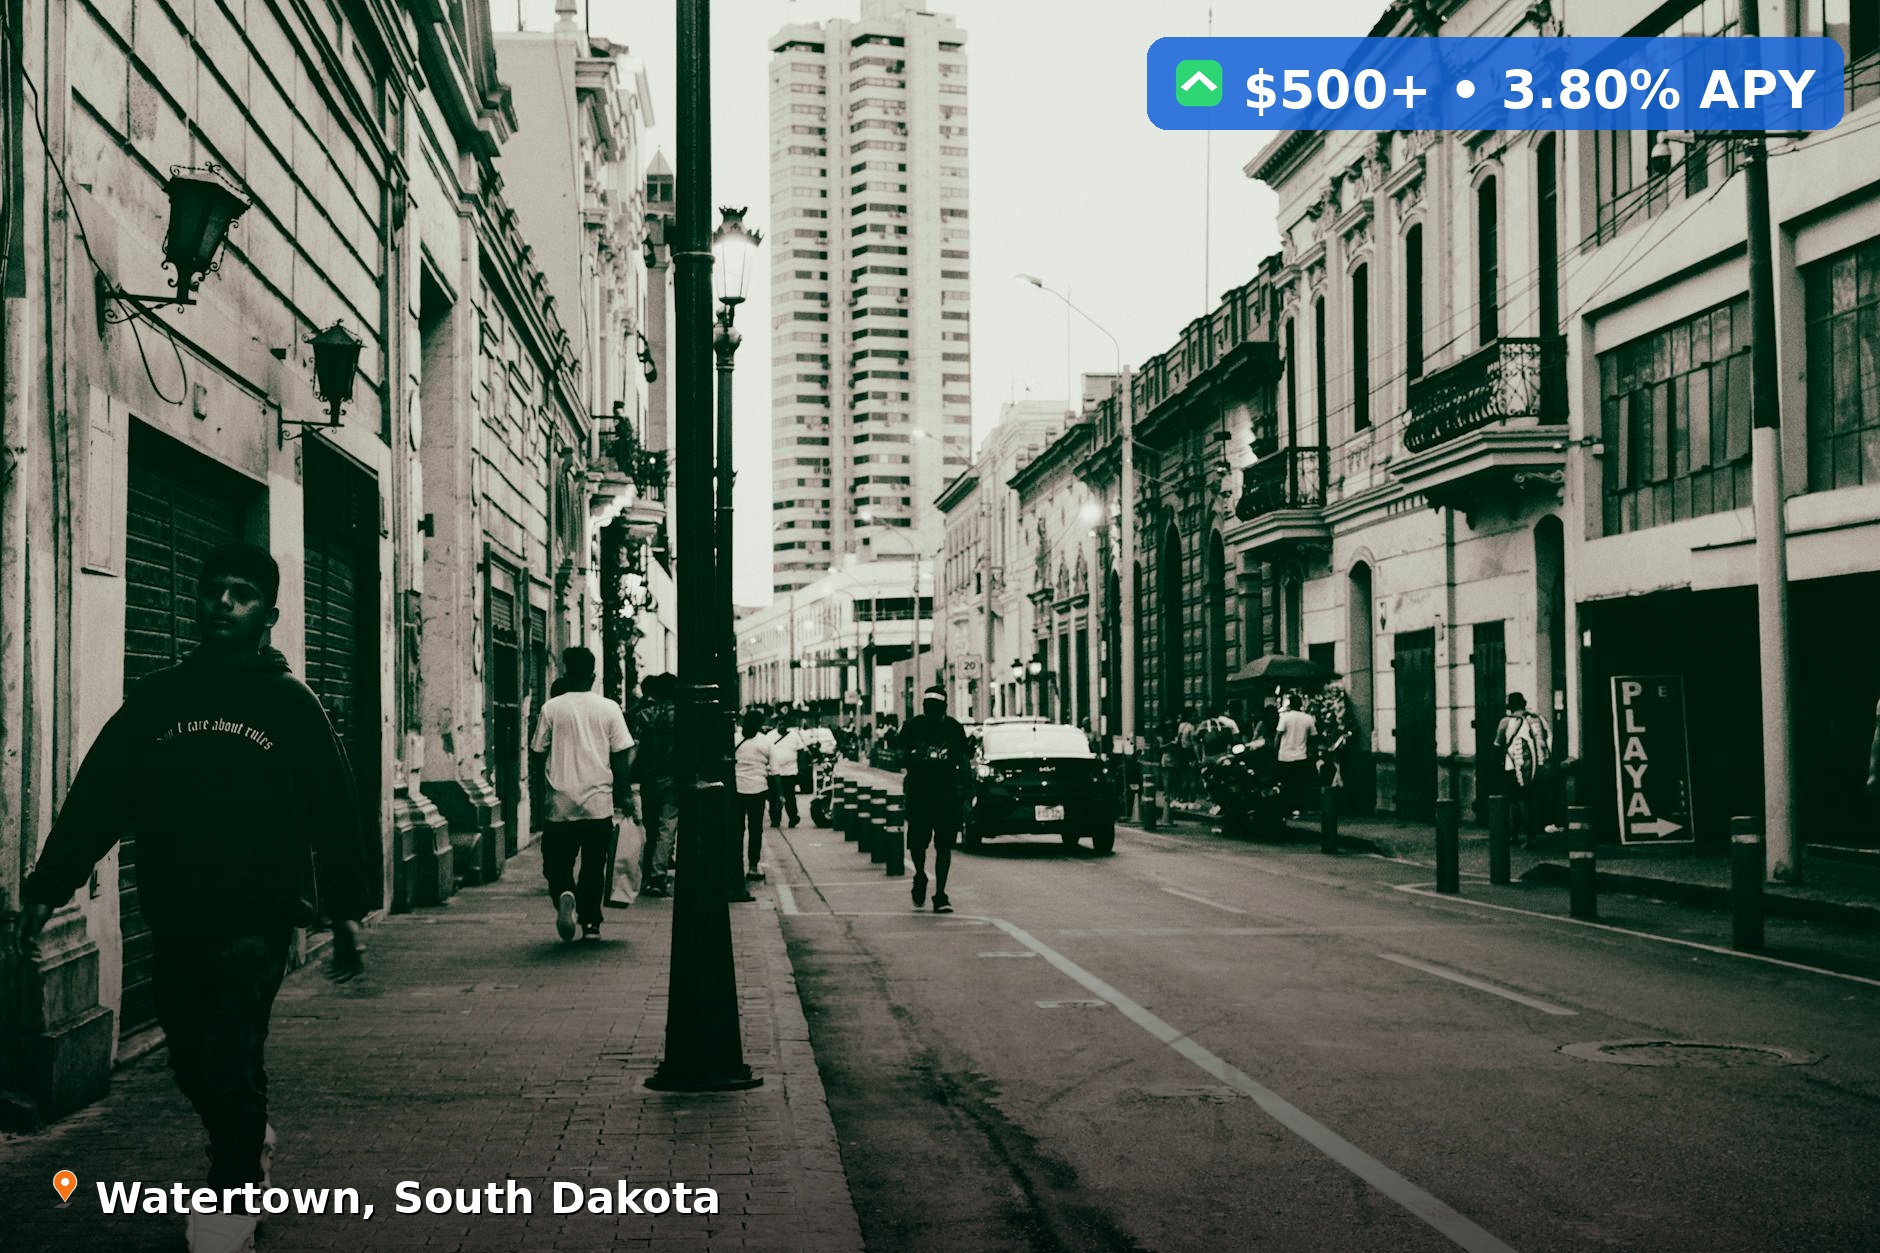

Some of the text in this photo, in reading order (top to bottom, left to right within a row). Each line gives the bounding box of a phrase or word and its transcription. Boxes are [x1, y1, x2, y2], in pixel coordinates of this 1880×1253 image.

[964, 661, 976, 670] 20
[187, 719, 209, 732] care
[211, 718, 244, 735] about
[244, 726, 273, 750] rules
[1621, 681, 1651, 817] PLAYA
